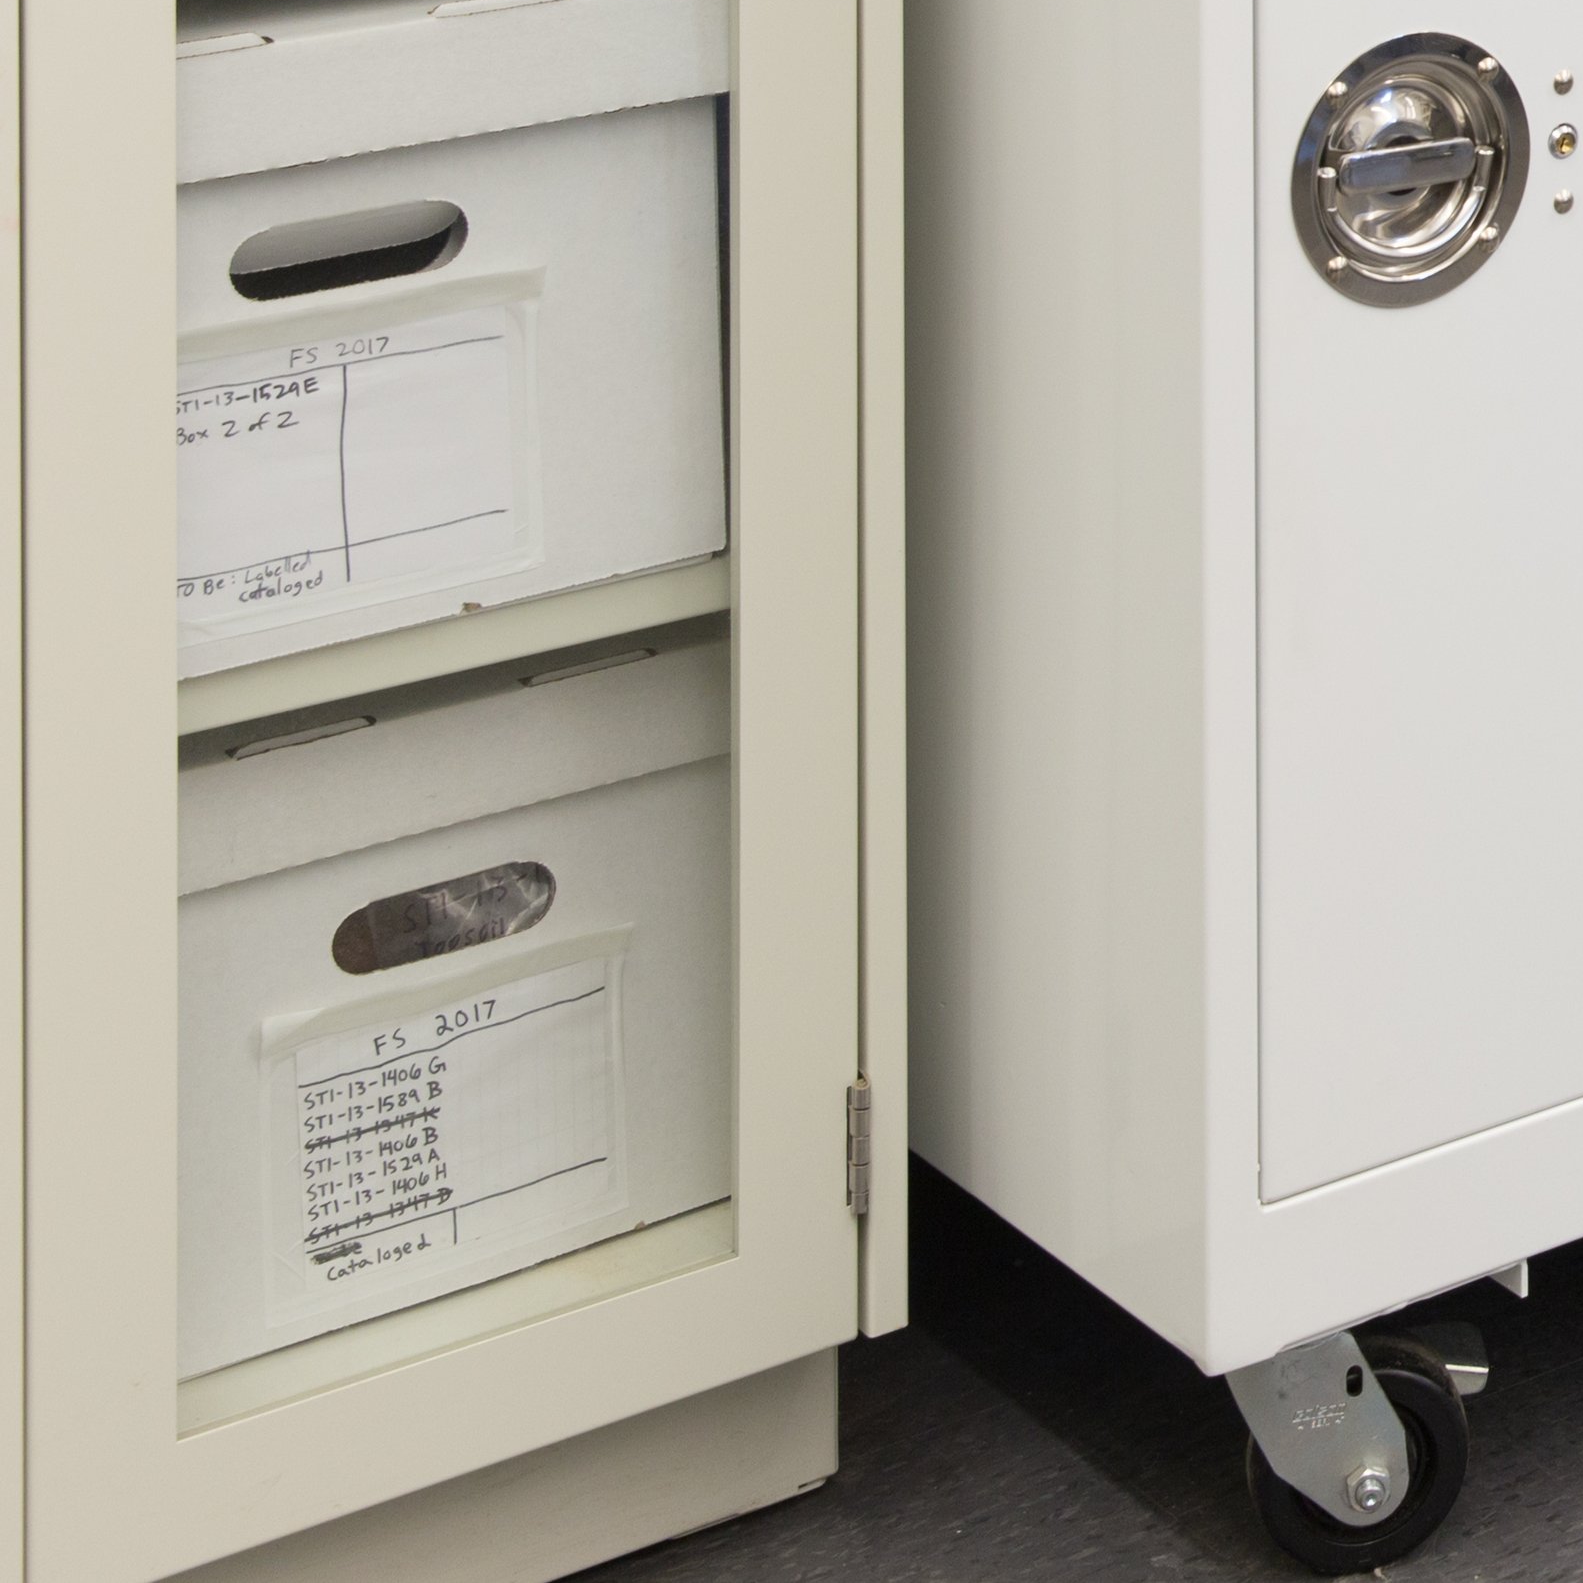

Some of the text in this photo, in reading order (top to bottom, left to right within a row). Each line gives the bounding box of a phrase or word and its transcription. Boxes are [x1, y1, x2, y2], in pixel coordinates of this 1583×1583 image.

[289, 336, 390, 368] FS 2017
[221, 420, 240, 438] 2
[248, 412, 271, 432] of
[277, 411, 300, 429] 2
[238, 570, 323, 603] cataloged
[373, 999, 496, 1055] FS 2017
[428, 1055, 447, 1075] G
[426, 1080, 443, 1101] B
[421, 1126, 439, 1146] B
[427, 1147, 441, 1164] A
[434, 1161, 448, 1181] H
